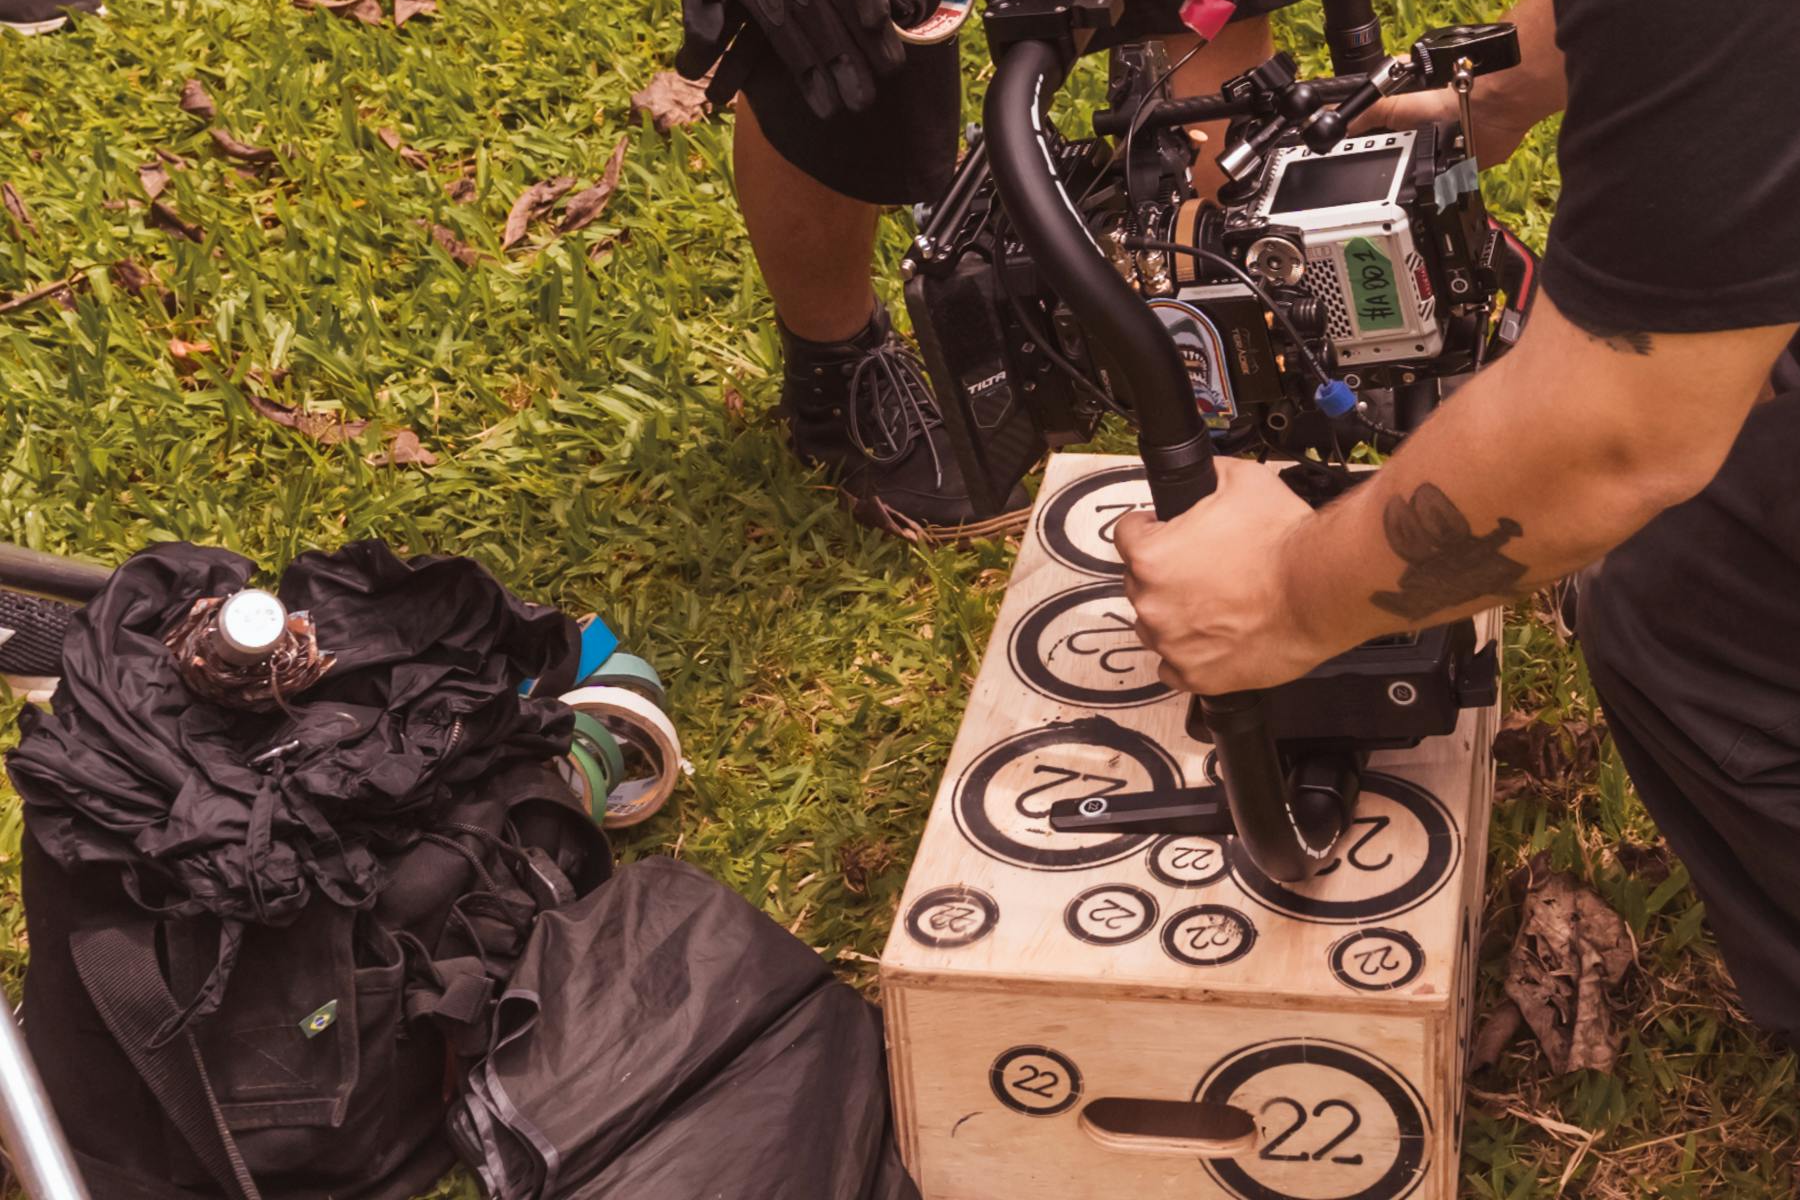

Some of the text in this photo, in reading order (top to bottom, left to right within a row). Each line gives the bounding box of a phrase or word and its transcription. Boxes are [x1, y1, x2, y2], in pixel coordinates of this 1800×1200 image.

[967, 369, 1007, 395] TILTA
[1173, 845, 1213, 872] 22
[1088, 898, 1138, 931] 22
[1185, 914, 1230, 950] 22
[1353, 945, 1401, 976] 22
[1011, 1064, 1060, 1098] 22
[1257, 1096, 1364, 1165] 22
